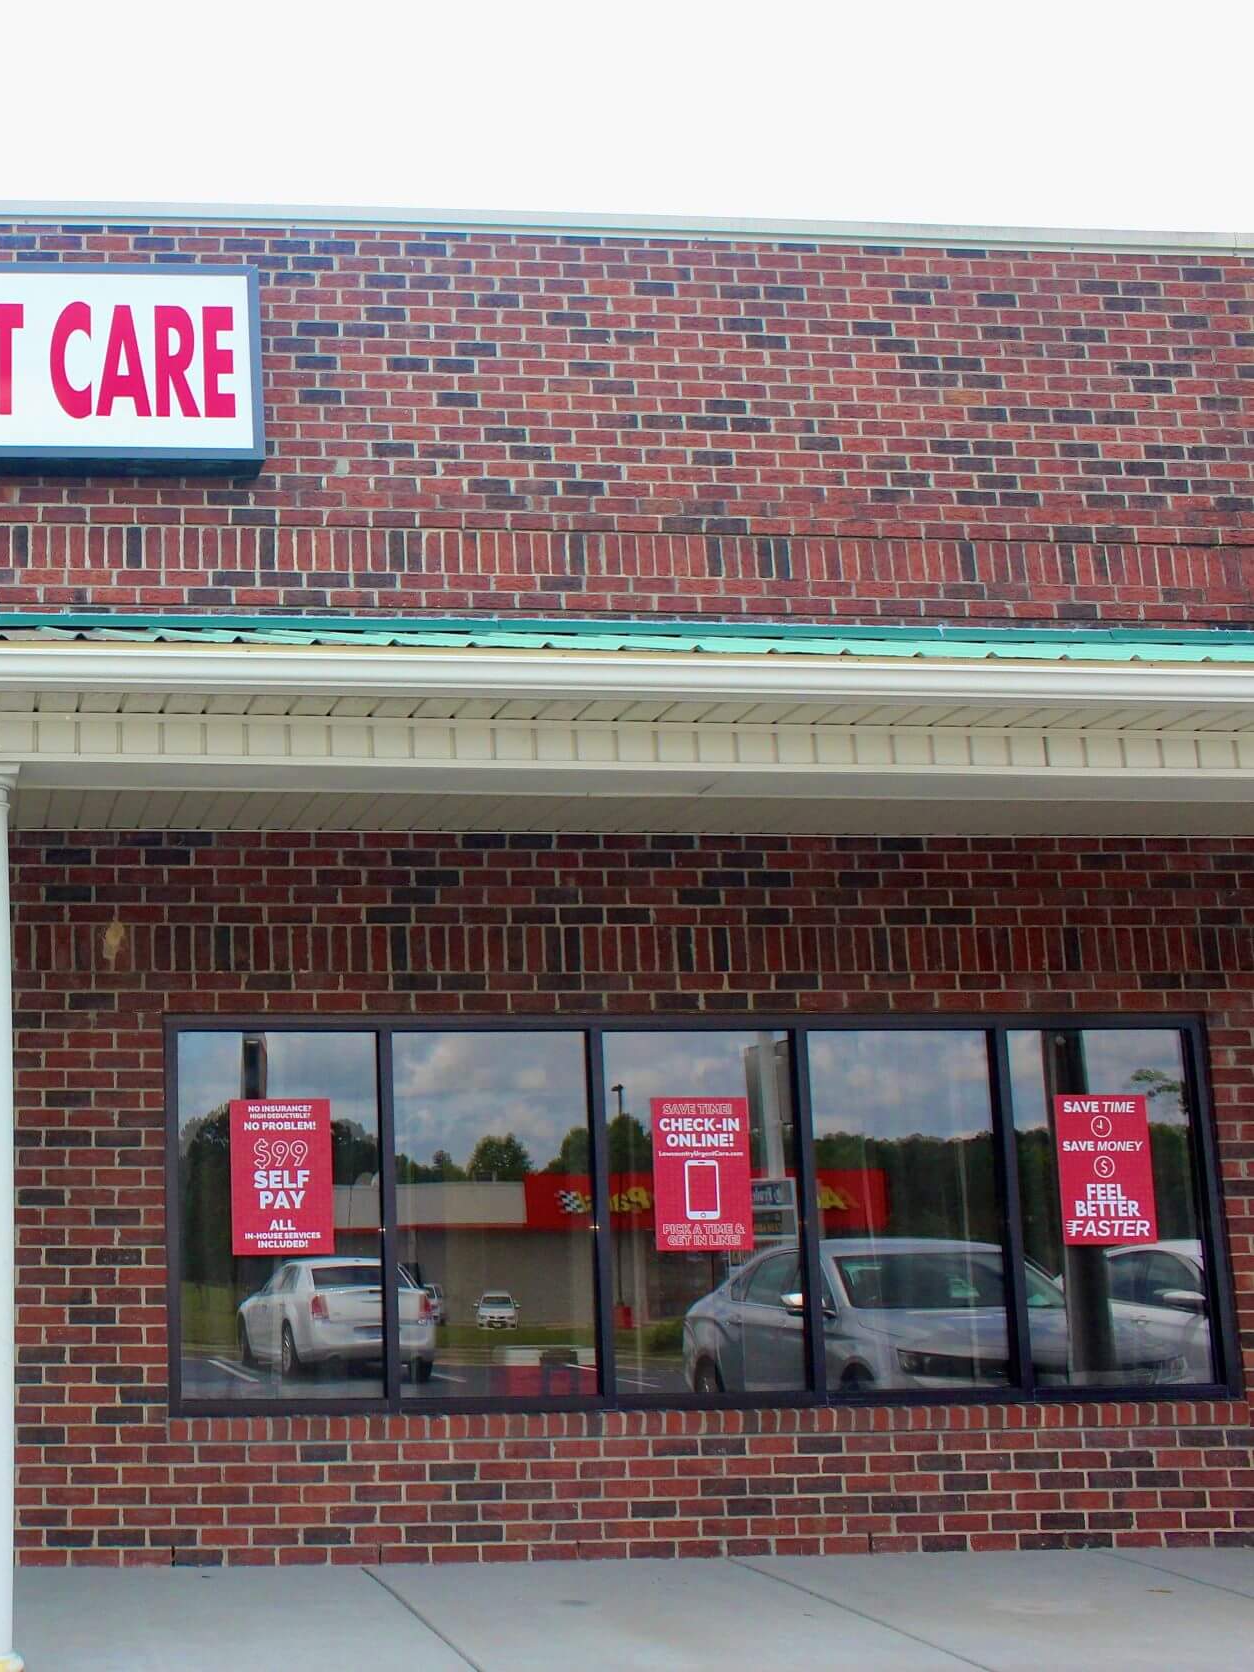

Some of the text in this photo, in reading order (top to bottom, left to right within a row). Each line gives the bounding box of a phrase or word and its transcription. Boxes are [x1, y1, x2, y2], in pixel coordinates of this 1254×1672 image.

[50, 301, 236, 419] CARE
[248, 1105, 313, 1113] NO INSURANCE?
[663, 1104, 733, 1115] SAVE TIME!
[1063, 1101, 1136, 1113] SAVE TIME
[244, 1121, 317, 1131] NO PROBLEM!
[659, 1118, 740, 1132] CHECK-IN
[666, 1134, 735, 1148] ONLINE!
[1063, 1141, 1143, 1152] SAVE MONEY
[254, 1138, 309, 1170] $99
[254, 1170, 310, 1189] SELF
[1086, 1184, 1127, 1200] FEEL
[259, 1191, 306, 1209] PAY
[1075, 1201, 1141, 1217] BETTER
[270, 1220, 296, 1231] ALL
[663, 1224, 745, 1234] PICK A TIME &
[1066, 1220, 1150, 1237] FASTER
[257, 1239, 308, 1248] INCLUDED!
[668, 1235, 692, 1245] GET
[694, 1235, 707, 1245] IN
